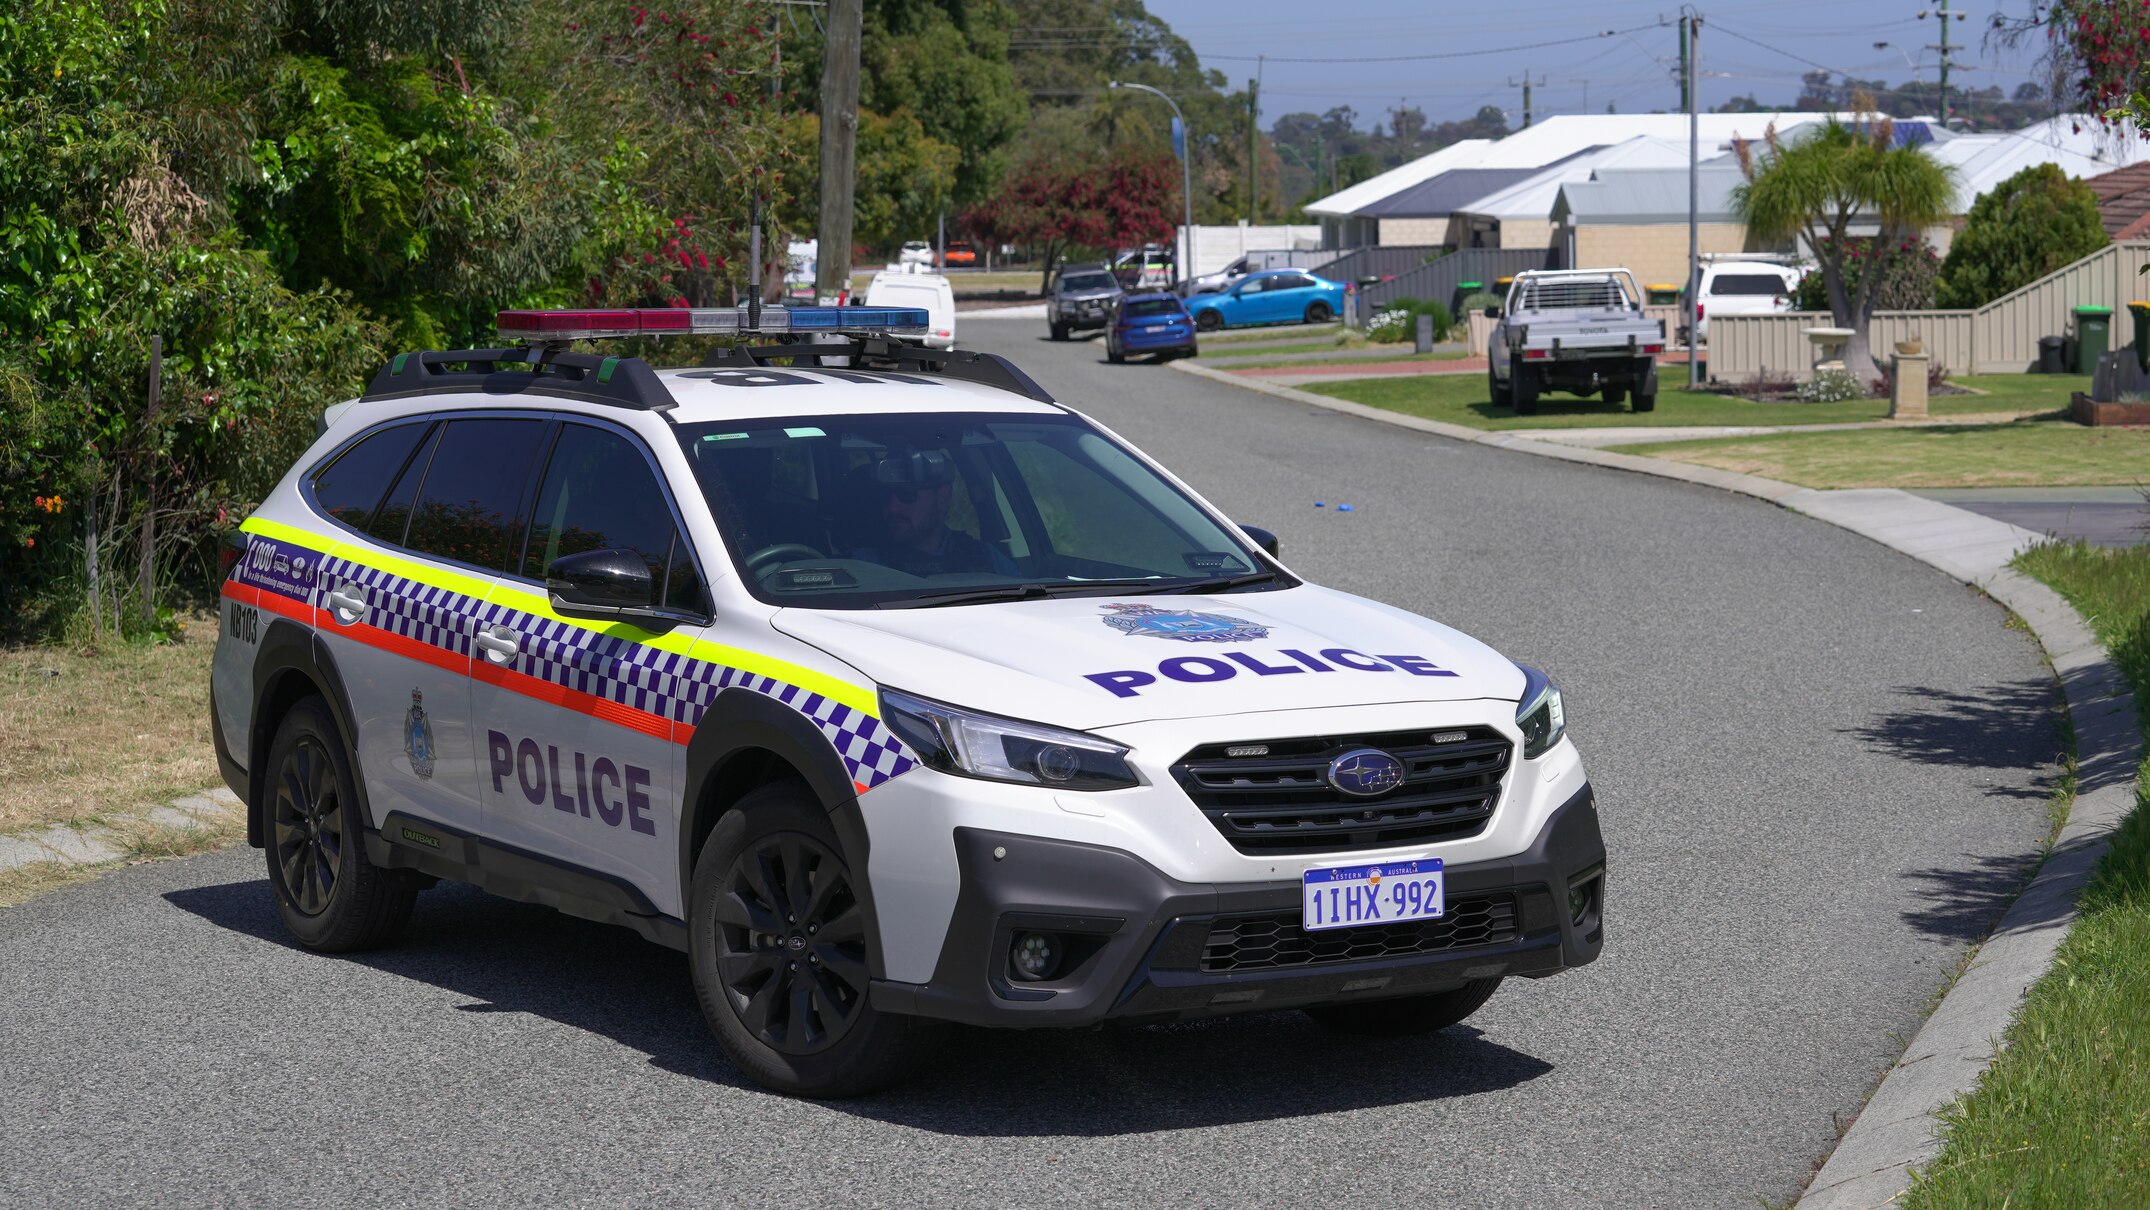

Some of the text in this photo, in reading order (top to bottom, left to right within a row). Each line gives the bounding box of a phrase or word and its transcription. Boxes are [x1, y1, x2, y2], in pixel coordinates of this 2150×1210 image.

[230, 601, 258, 645] NB103
[1082, 648, 1462, 698] POLICE
[488, 729, 656, 836] POLICE
[403, 828, 440, 849] OUTBACK
[1330, 872, 1362, 881] WESTERN
